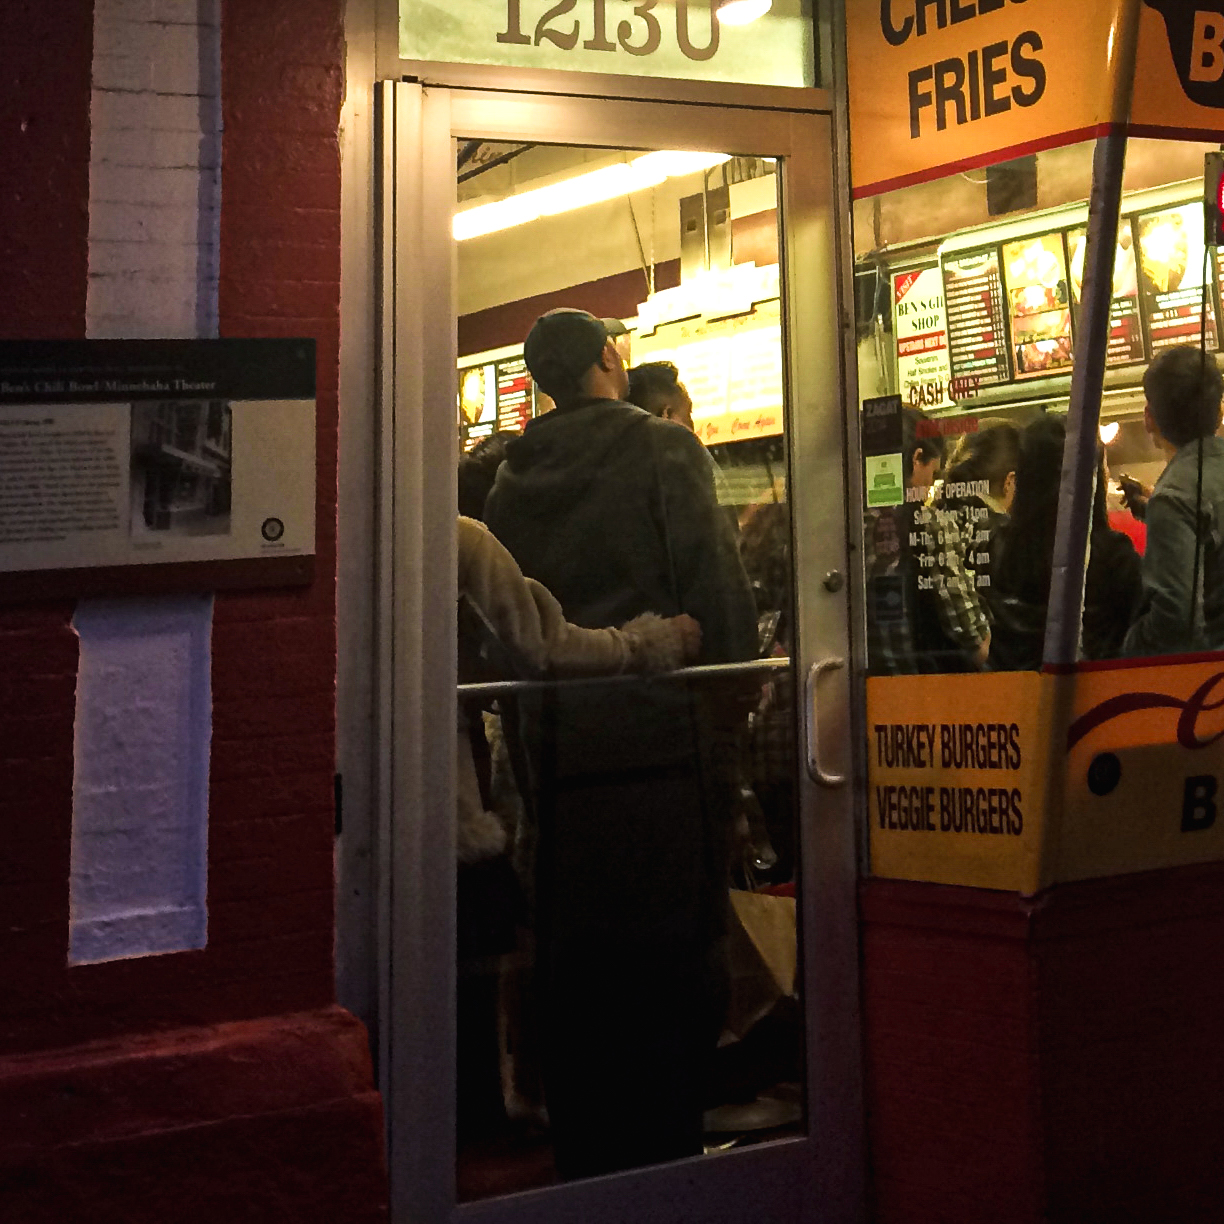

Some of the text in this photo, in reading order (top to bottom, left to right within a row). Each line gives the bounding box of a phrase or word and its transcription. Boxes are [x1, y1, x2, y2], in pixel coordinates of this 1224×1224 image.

[907, 29, 1047, 140] FRIES
[911, 314, 940, 332] SHOP
[909, 375, 981, 408] CASH ONLY
[945, 479, 990, 498] OPERATION
[874, 722, 1021, 771] TURKEY BURGERS
[876, 785, 1024, 836] VEGGIE BURGERS
